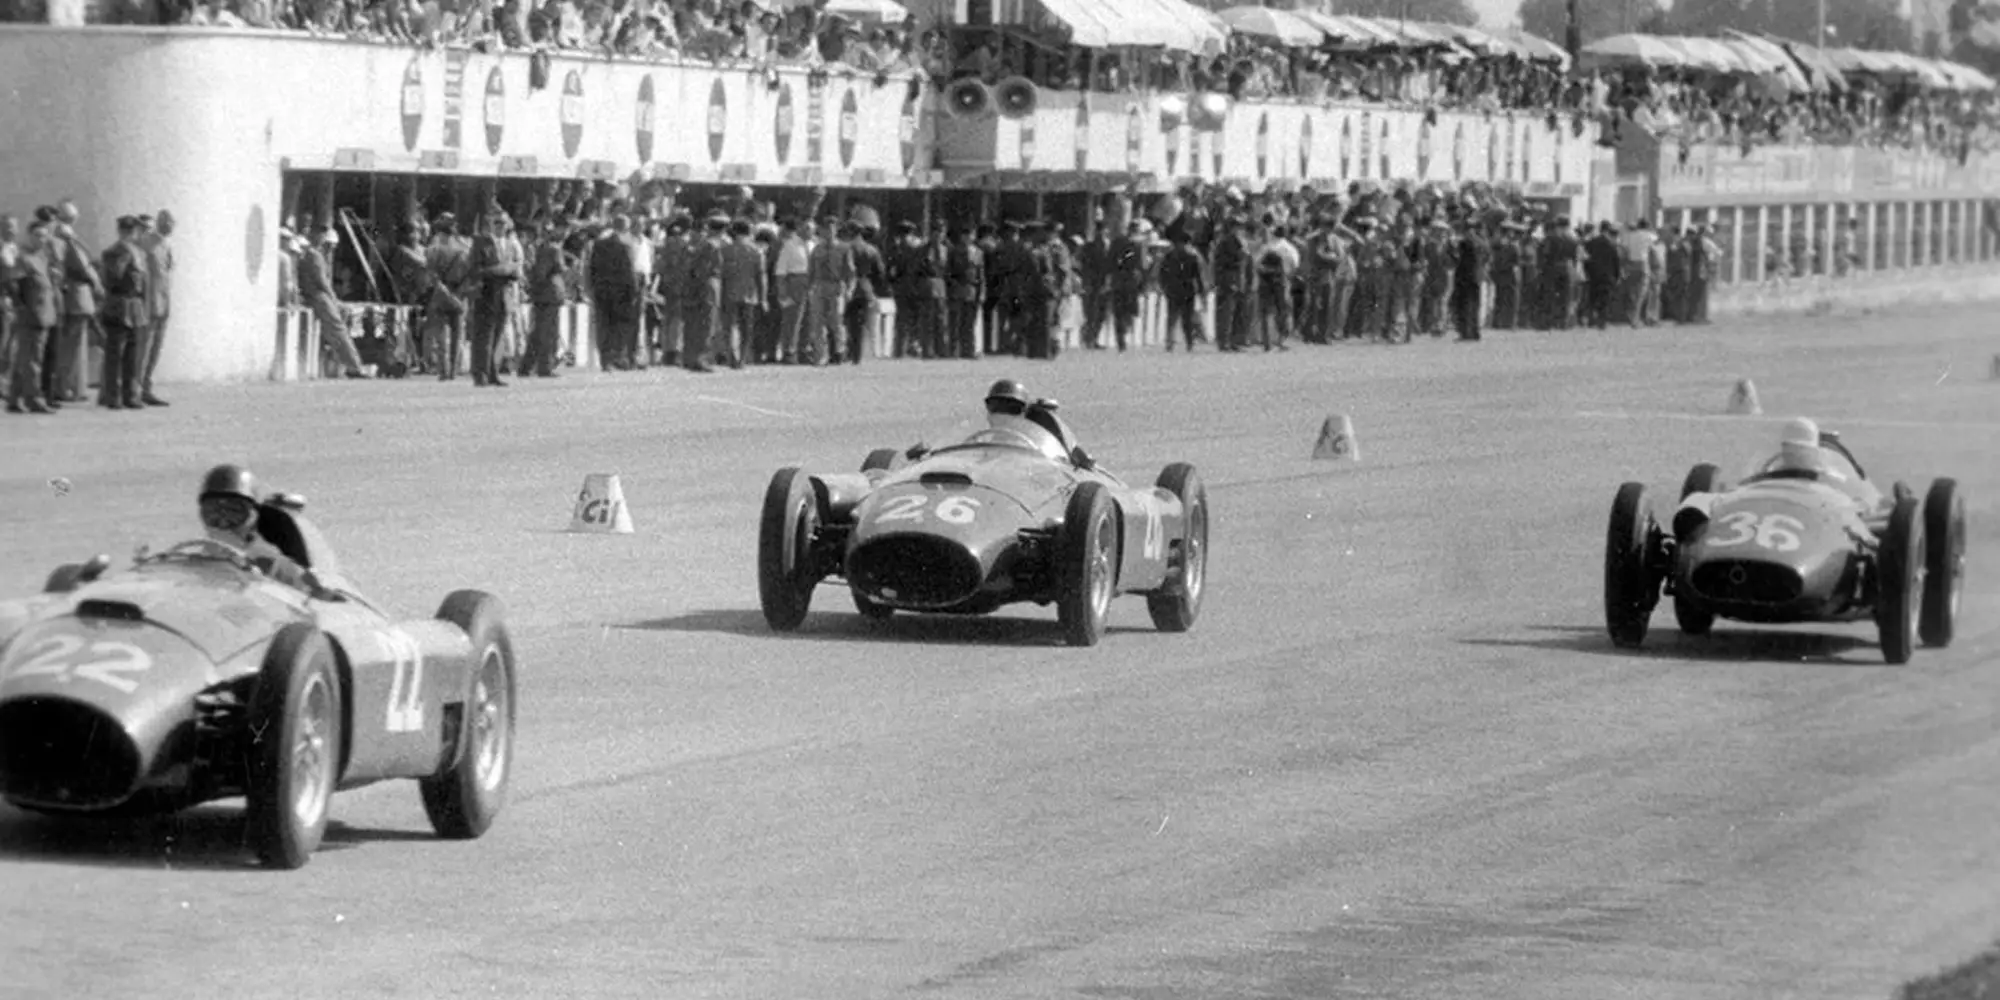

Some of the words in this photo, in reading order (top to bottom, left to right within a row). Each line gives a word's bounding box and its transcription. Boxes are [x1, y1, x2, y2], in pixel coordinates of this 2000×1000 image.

[876, 495, 980, 524] 26
[1705, 511, 1805, 552] 36
[7, 634, 152, 694] 22
[374, 626, 423, 731] 22
